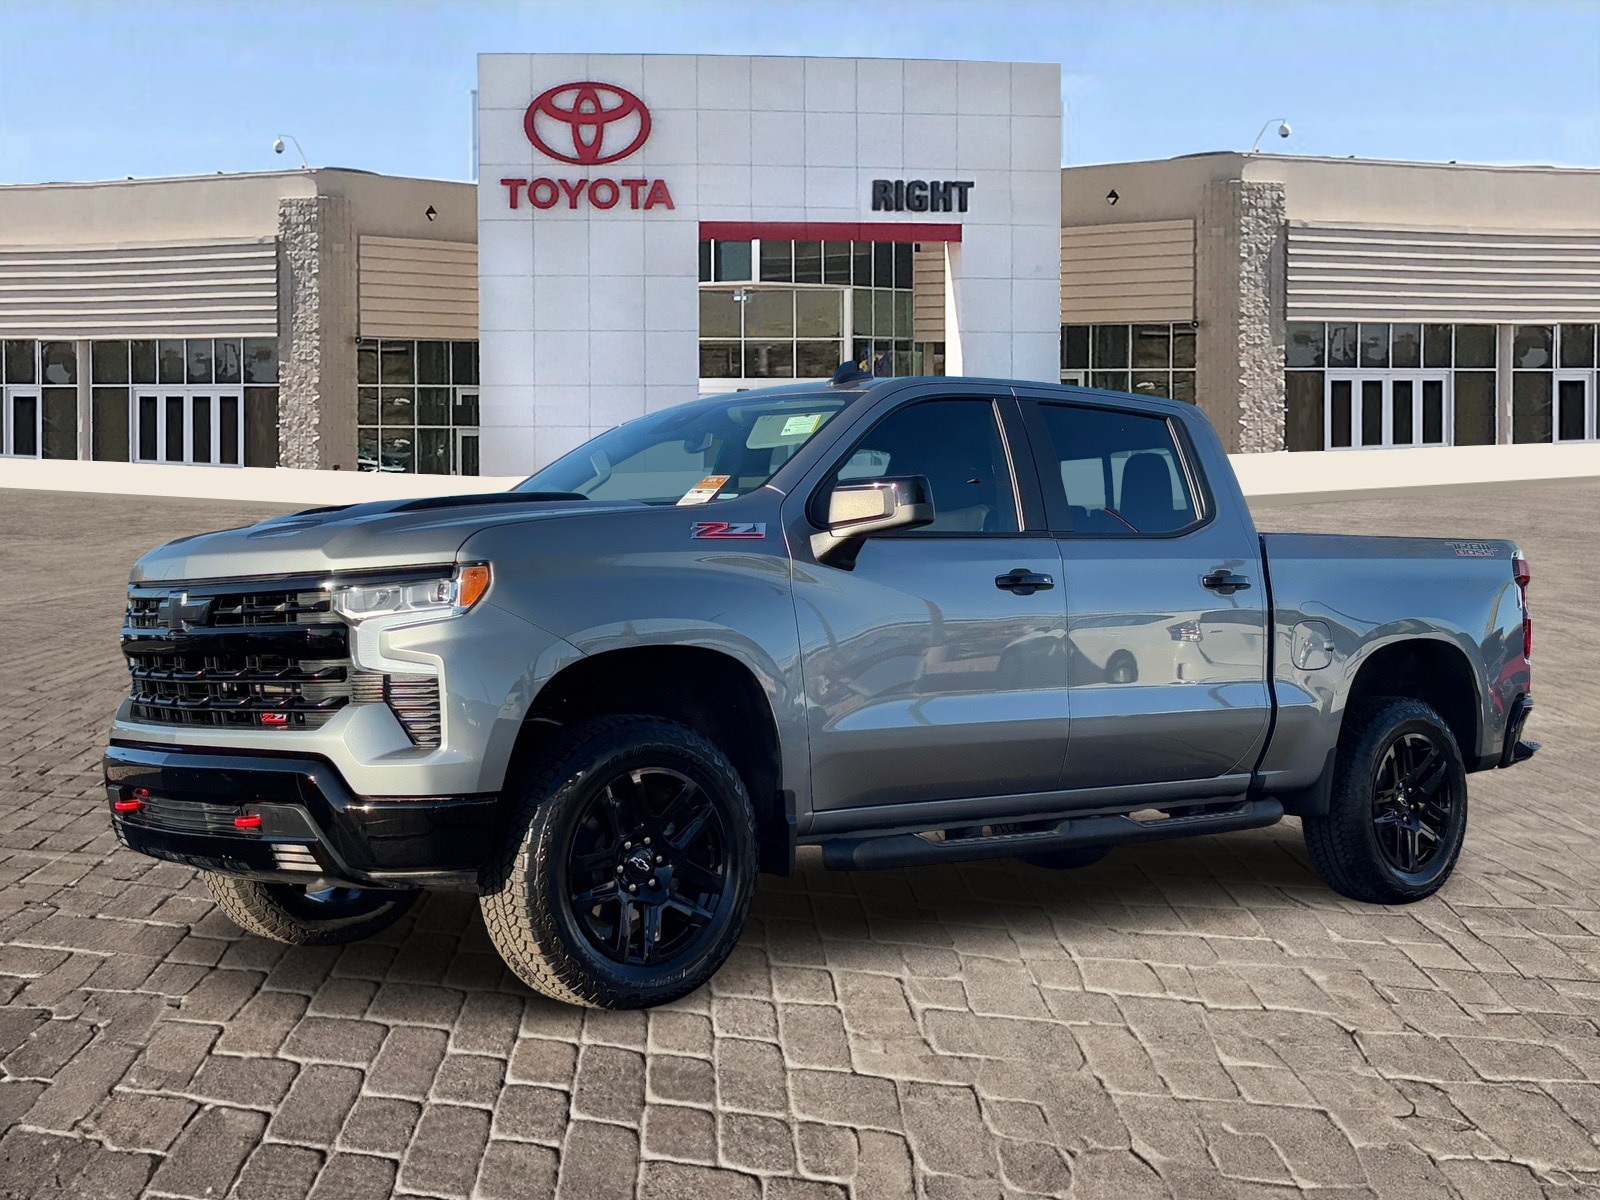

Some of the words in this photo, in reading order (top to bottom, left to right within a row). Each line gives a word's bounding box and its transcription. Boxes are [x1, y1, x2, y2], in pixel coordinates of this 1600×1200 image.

[500, 178, 675, 210] TOYOTA
[871, 179, 975, 213] RIGHT
[691, 521, 767, 539] Z71
